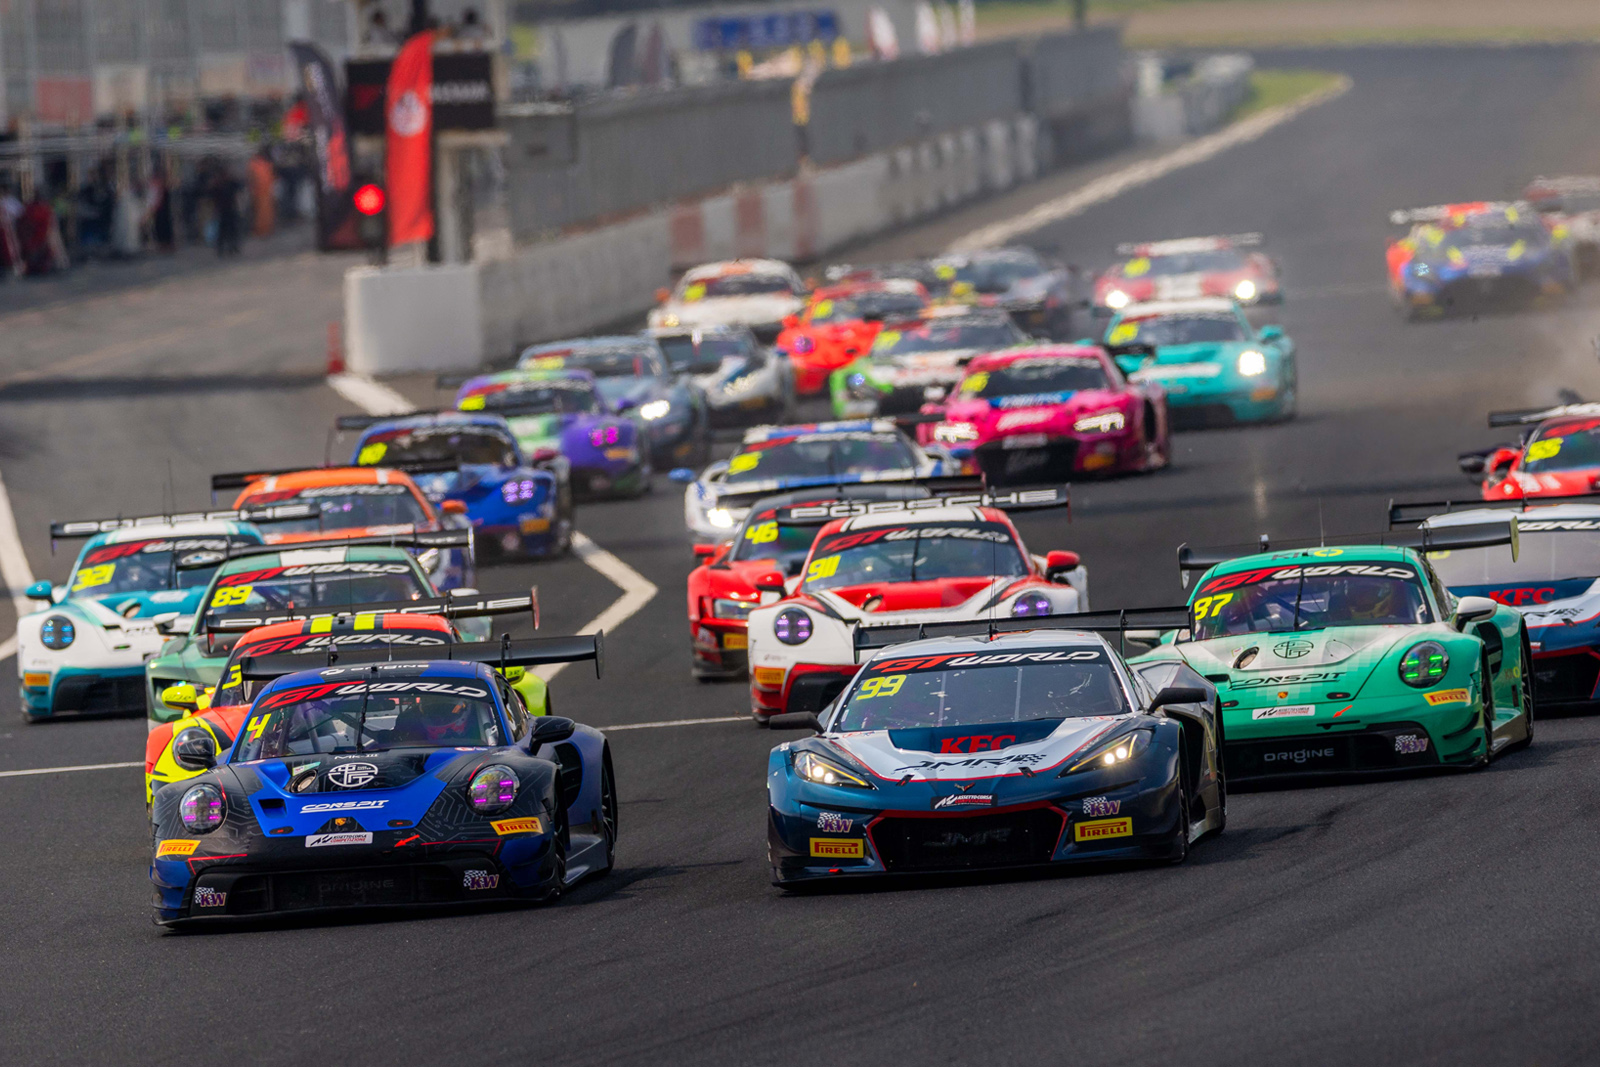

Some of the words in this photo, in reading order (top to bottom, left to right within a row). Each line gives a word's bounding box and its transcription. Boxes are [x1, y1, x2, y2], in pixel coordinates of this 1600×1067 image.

[790, 489, 1057, 519] PORSCHE
[745, 522, 778, 545] 46
[282, 563, 411, 576] WORLD
[805, 555, 842, 583] 911
[1200, 565, 1300, 593] GT
[1271, 565, 1415, 580] WORLD
[209, 586, 254, 607] 89
[1489, 588, 1556, 606] KFC
[1194, 593, 1234, 621] 87
[236, 633, 334, 660] GT
[304, 634, 446, 647] WORLD
[870, 653, 977, 673] GT
[947, 651, 1101, 666] WORLD
[259, 680, 366, 709] GT
[334, 682, 488, 698] WORLD
[855, 674, 907, 701] 99
[1429, 691, 1468, 703] PIRELLI
[246, 713, 272, 739] 4
[940, 735, 1016, 754] KFC
[1400, 738, 1429, 754] KW
[300, 800, 390, 811] CONSPIT
[1090, 800, 1121, 817] KW
[496, 820, 539, 832] PIRELLI
[823, 818, 853, 833] KW
[1080, 821, 1128, 838] PIRELLI
[159, 843, 195, 854] PIRELLI
[814, 841, 859, 855] PIRELLI
[469, 874, 500, 890] KW
[200, 892, 227, 908] KW
